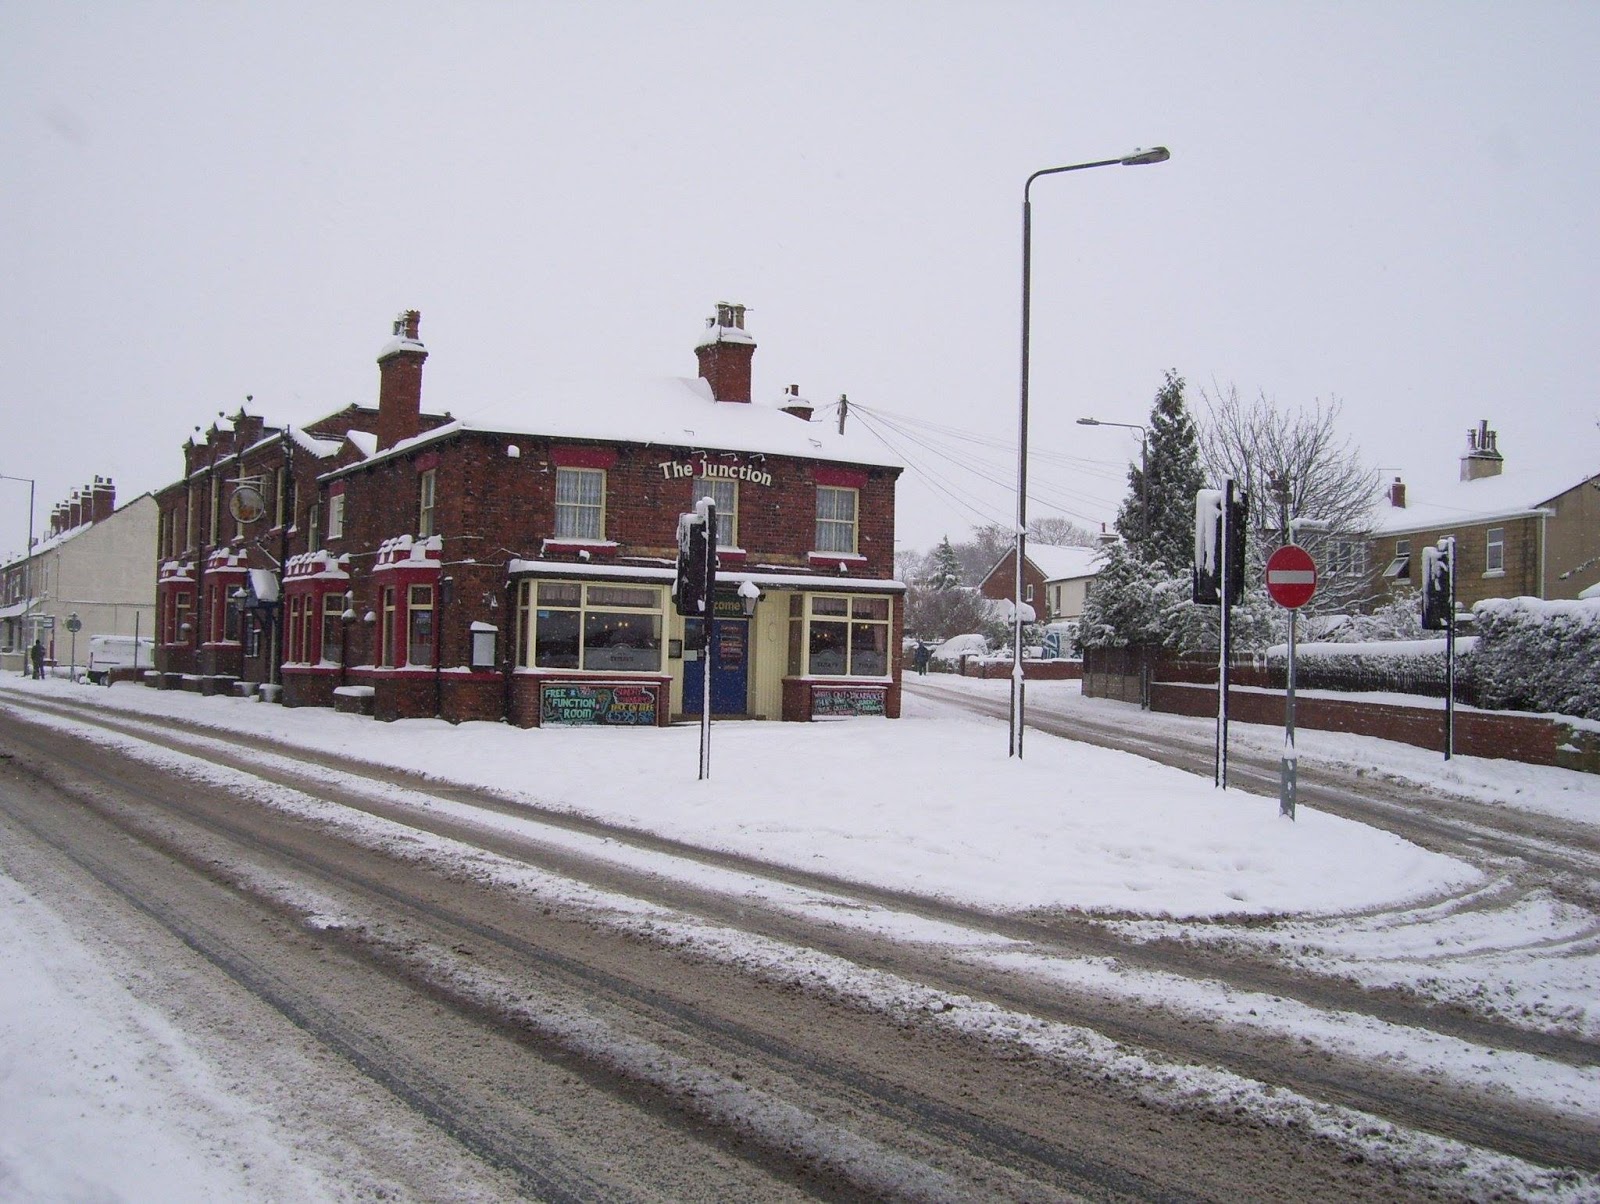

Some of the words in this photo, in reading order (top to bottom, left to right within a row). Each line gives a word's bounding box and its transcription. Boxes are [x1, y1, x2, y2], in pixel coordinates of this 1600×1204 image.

[658, 460, 693, 480] The
[699, 459, 772, 487] Junction
[545, 688, 567, 698] FREE
[552, 698, 596, 708] FUNCTION
[563, 708, 592, 719] ROOM
